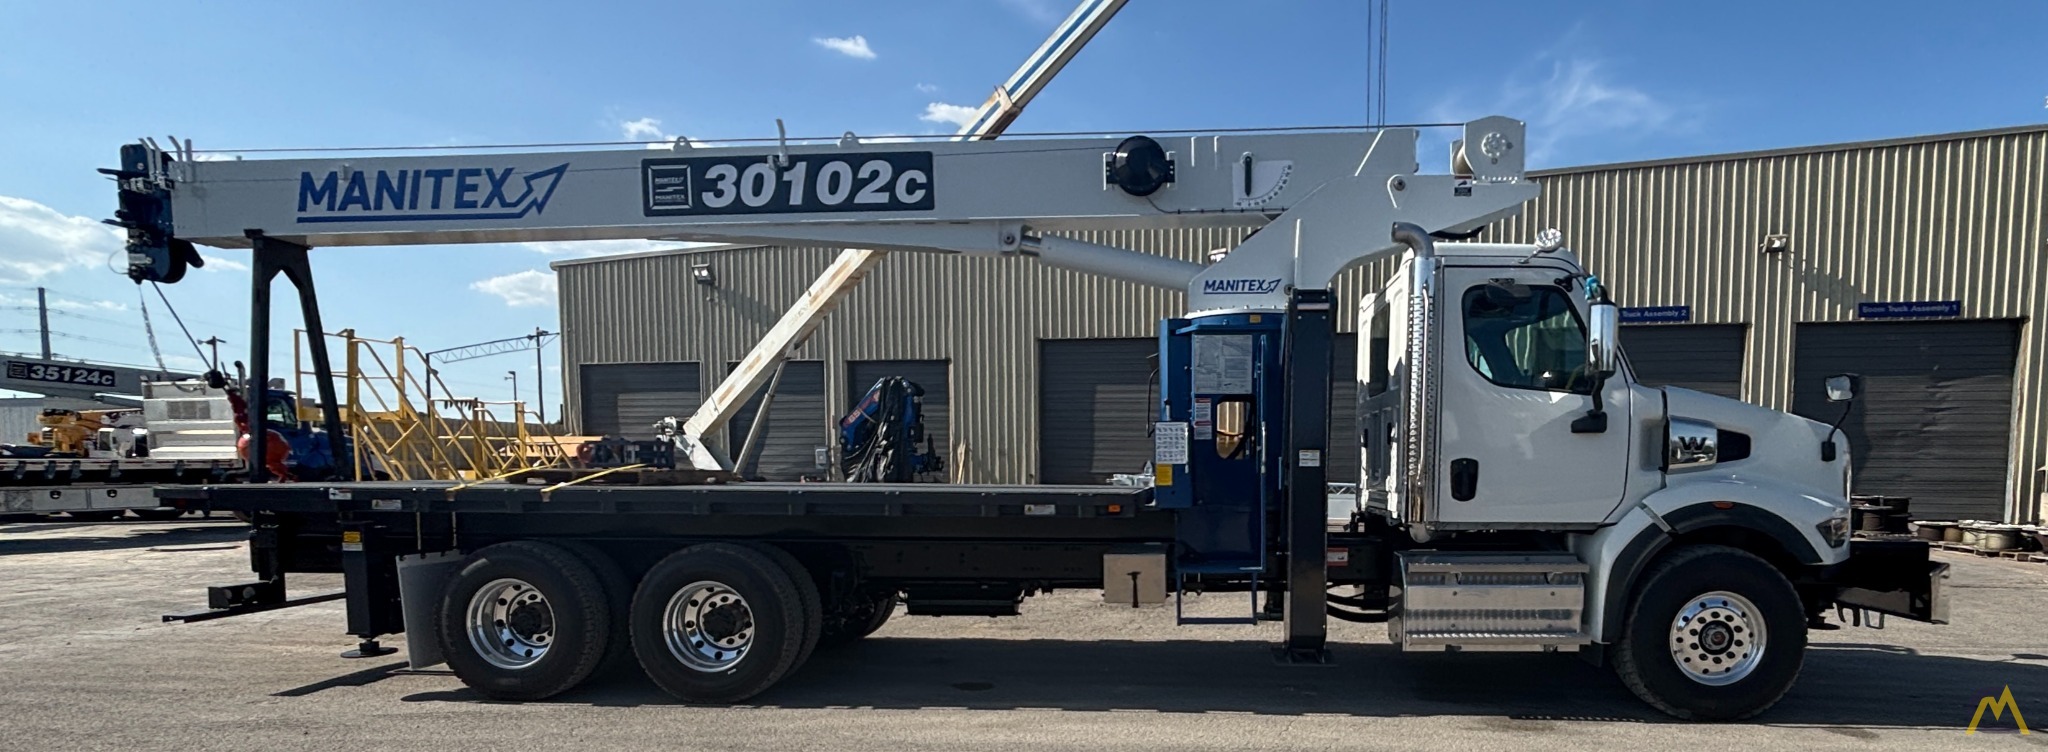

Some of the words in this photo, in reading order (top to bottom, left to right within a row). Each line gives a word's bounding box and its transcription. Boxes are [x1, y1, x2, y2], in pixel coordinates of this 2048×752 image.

[297, 167, 516, 213] MANITEX
[701, 159, 928, 209] 30102c
[1203, 279, 1267, 292] MANITEX
[1622, 310, 1641, 318] Truck
[1643, 310, 1679, 318] Assembly
[1681, 309, 1687, 317] 2
[1862, 305, 1886, 313] Boom
[1887, 304, 1909, 312] Truck
[1911, 303, 1950, 313] Assembly
[30, 364, 114, 386] 35124c
[1677, 435, 1708, 452] W
